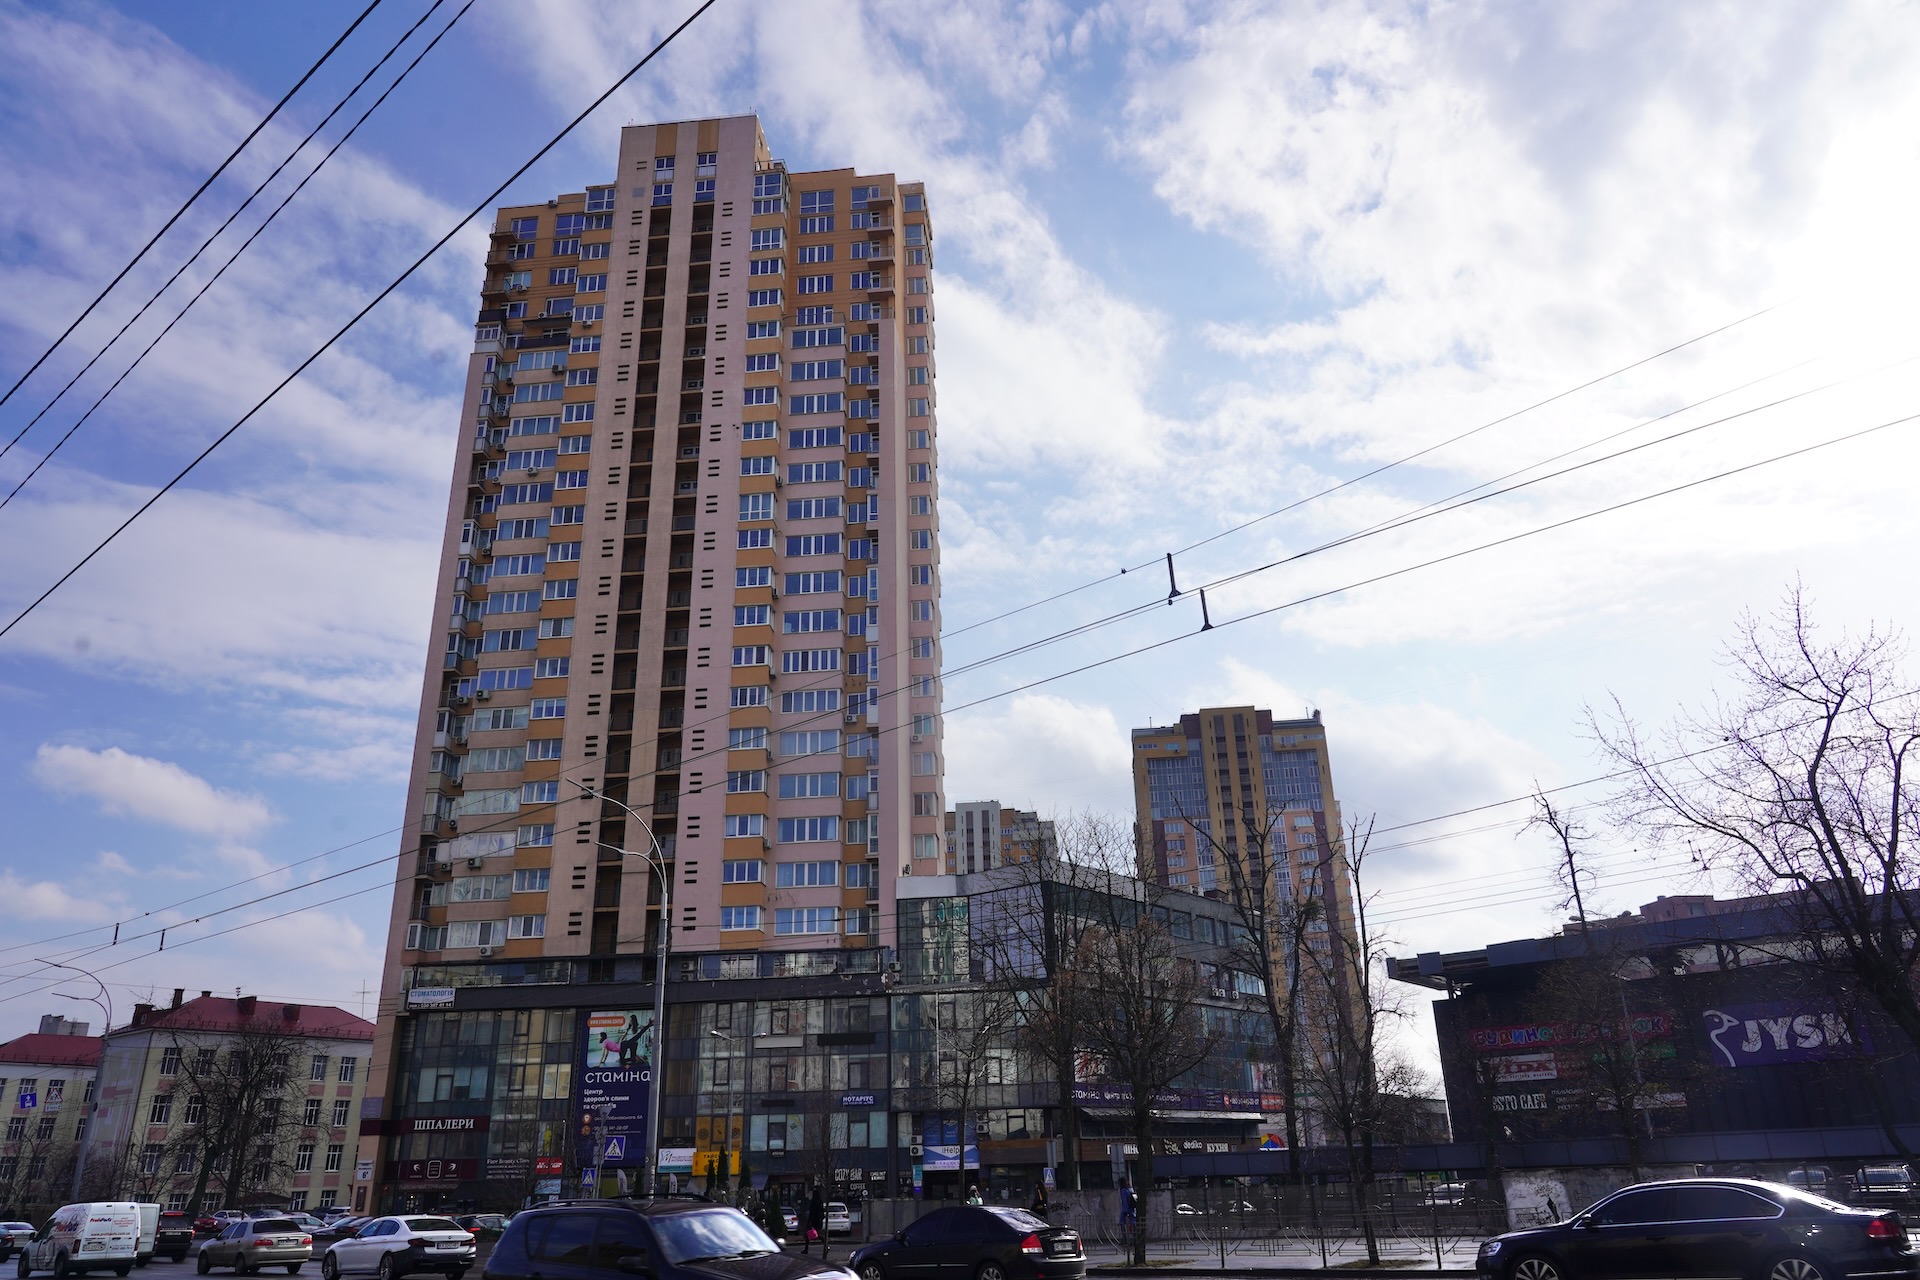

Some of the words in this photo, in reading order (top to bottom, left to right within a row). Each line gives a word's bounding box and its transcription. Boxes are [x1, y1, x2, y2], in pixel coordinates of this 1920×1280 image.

[410, 989, 454, 997] СТОМАТОЛОГІЯ
[1741, 1012, 1853, 1053] JYSK
[1492, 1095, 1518, 1112] ESTO
[1519, 1093, 1547, 1110] CAFE
[413, 1119, 475, 1131] ШПАЛЕРИ
[1206, 1142, 1229, 1152] КУХНЯ
[834, 1168, 849, 1181] COZY
[850, 1167, 863, 1181] BAR
[849, 1182, 866, 1191] COFFEE
